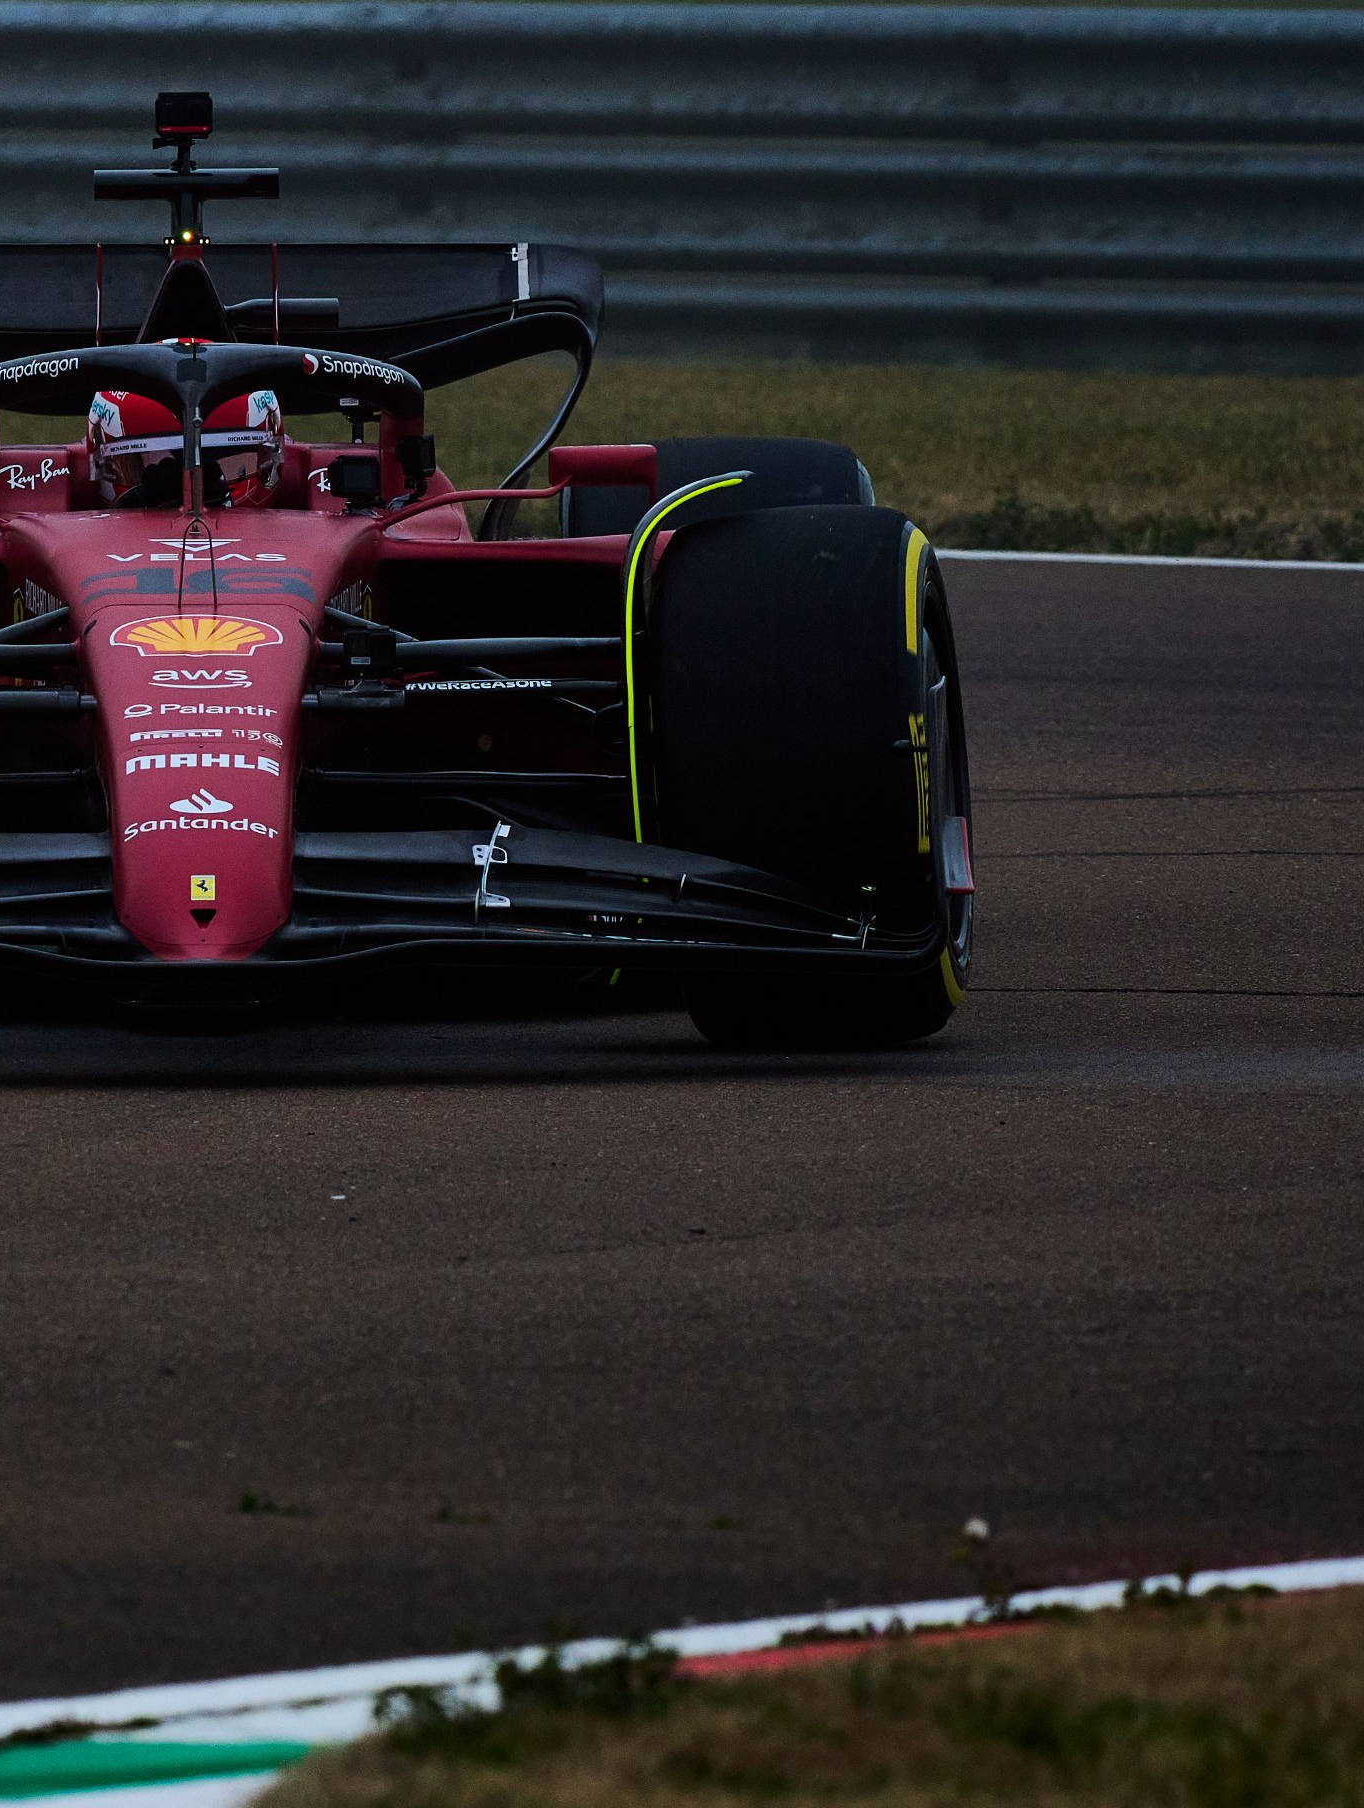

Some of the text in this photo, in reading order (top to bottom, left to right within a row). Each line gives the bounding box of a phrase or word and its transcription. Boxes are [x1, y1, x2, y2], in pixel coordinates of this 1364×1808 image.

[322, 355, 405, 384] Snapdragon
[106, 553, 287, 562] VELAS
[80, 567, 317, 603] 16
[152, 669, 249, 681] aws
[405, 679, 552, 691] #WeRaceAsOne
[160, 703, 278, 717] Palantir
[130, 728, 224, 742] PIRELLI
[125, 753, 281, 777] MAHLE
[124, 816, 279, 842] Santander
